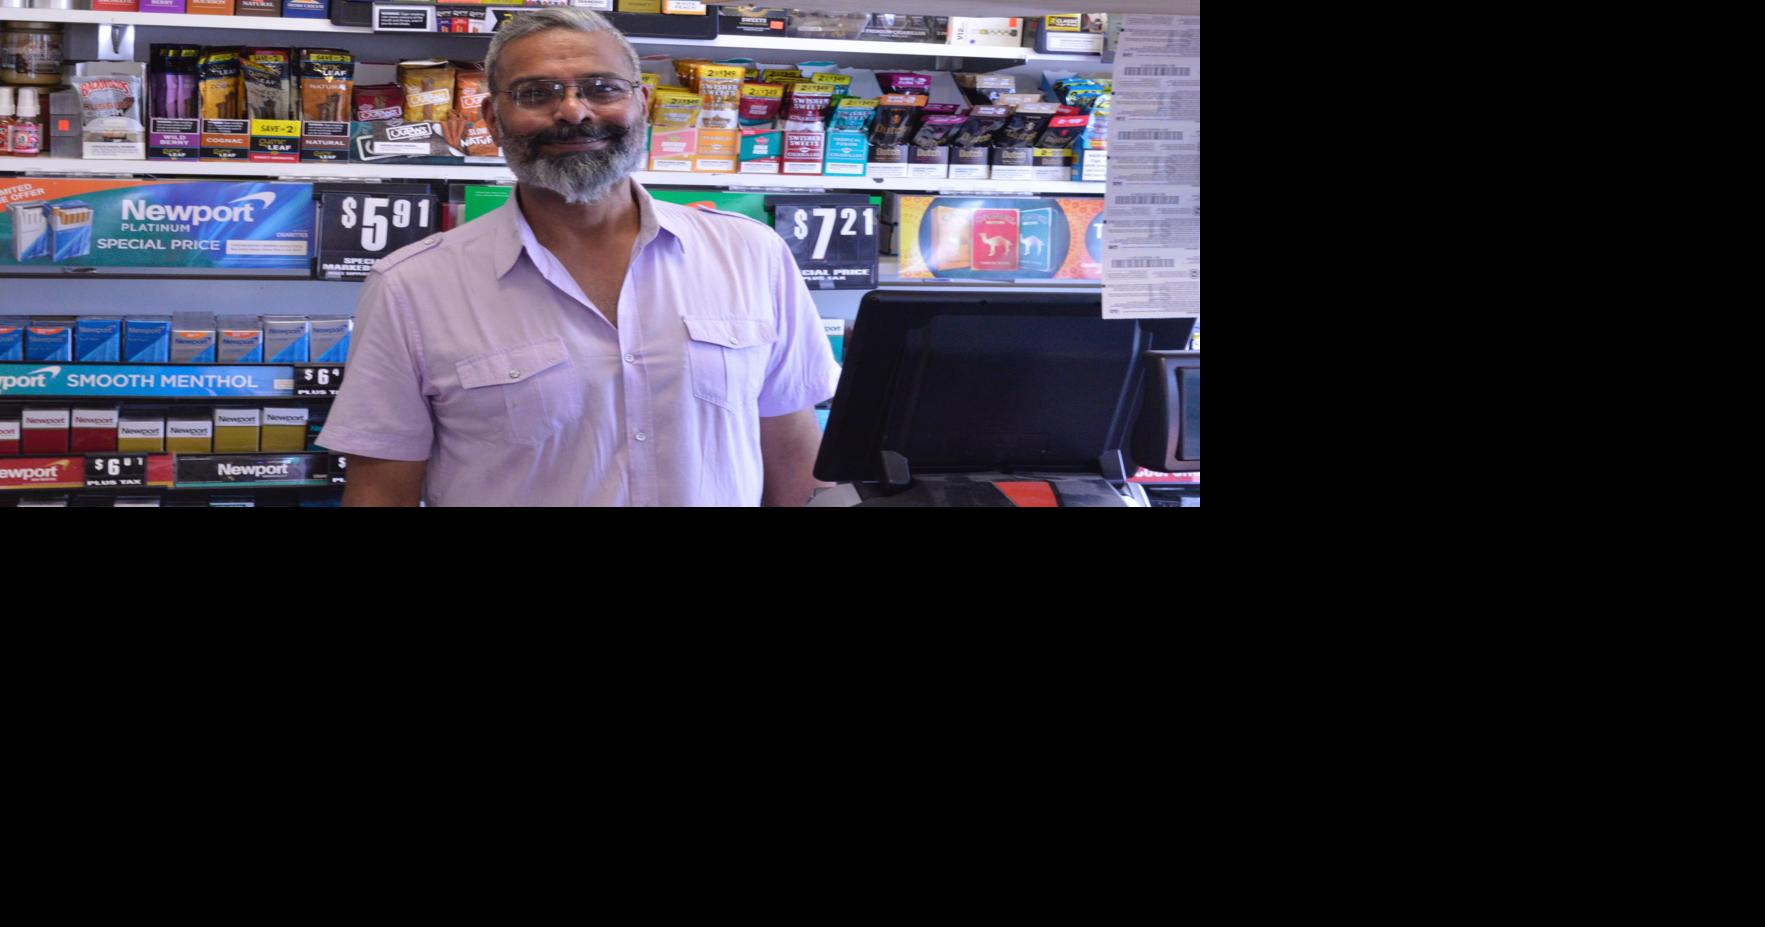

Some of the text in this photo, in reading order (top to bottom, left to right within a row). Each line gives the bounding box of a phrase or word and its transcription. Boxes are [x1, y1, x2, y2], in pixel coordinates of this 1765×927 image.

[261, 124, 280, 133] SAVE
[10, 187, 46, 201] OFFER
[121, 199, 254, 226] Newport
[120, 223, 191, 233] PLATINUM
[96, 238, 166, 250] SPECIAL
[171, 239, 220, 251] PRICE
[833, 268, 870, 276] PRICE
[0, 373, 259, 391] port SMOOTH MENTHOL
[26, 416, 65, 425] Newport
[75, 416, 114, 425] Newport
[218, 414, 256, 424] Newport
[266, 413, 305, 423] Newport
[120, 427, 160, 436] Newport
[169, 426, 209, 436] Newport
[217, 463, 289, 478] Newport
